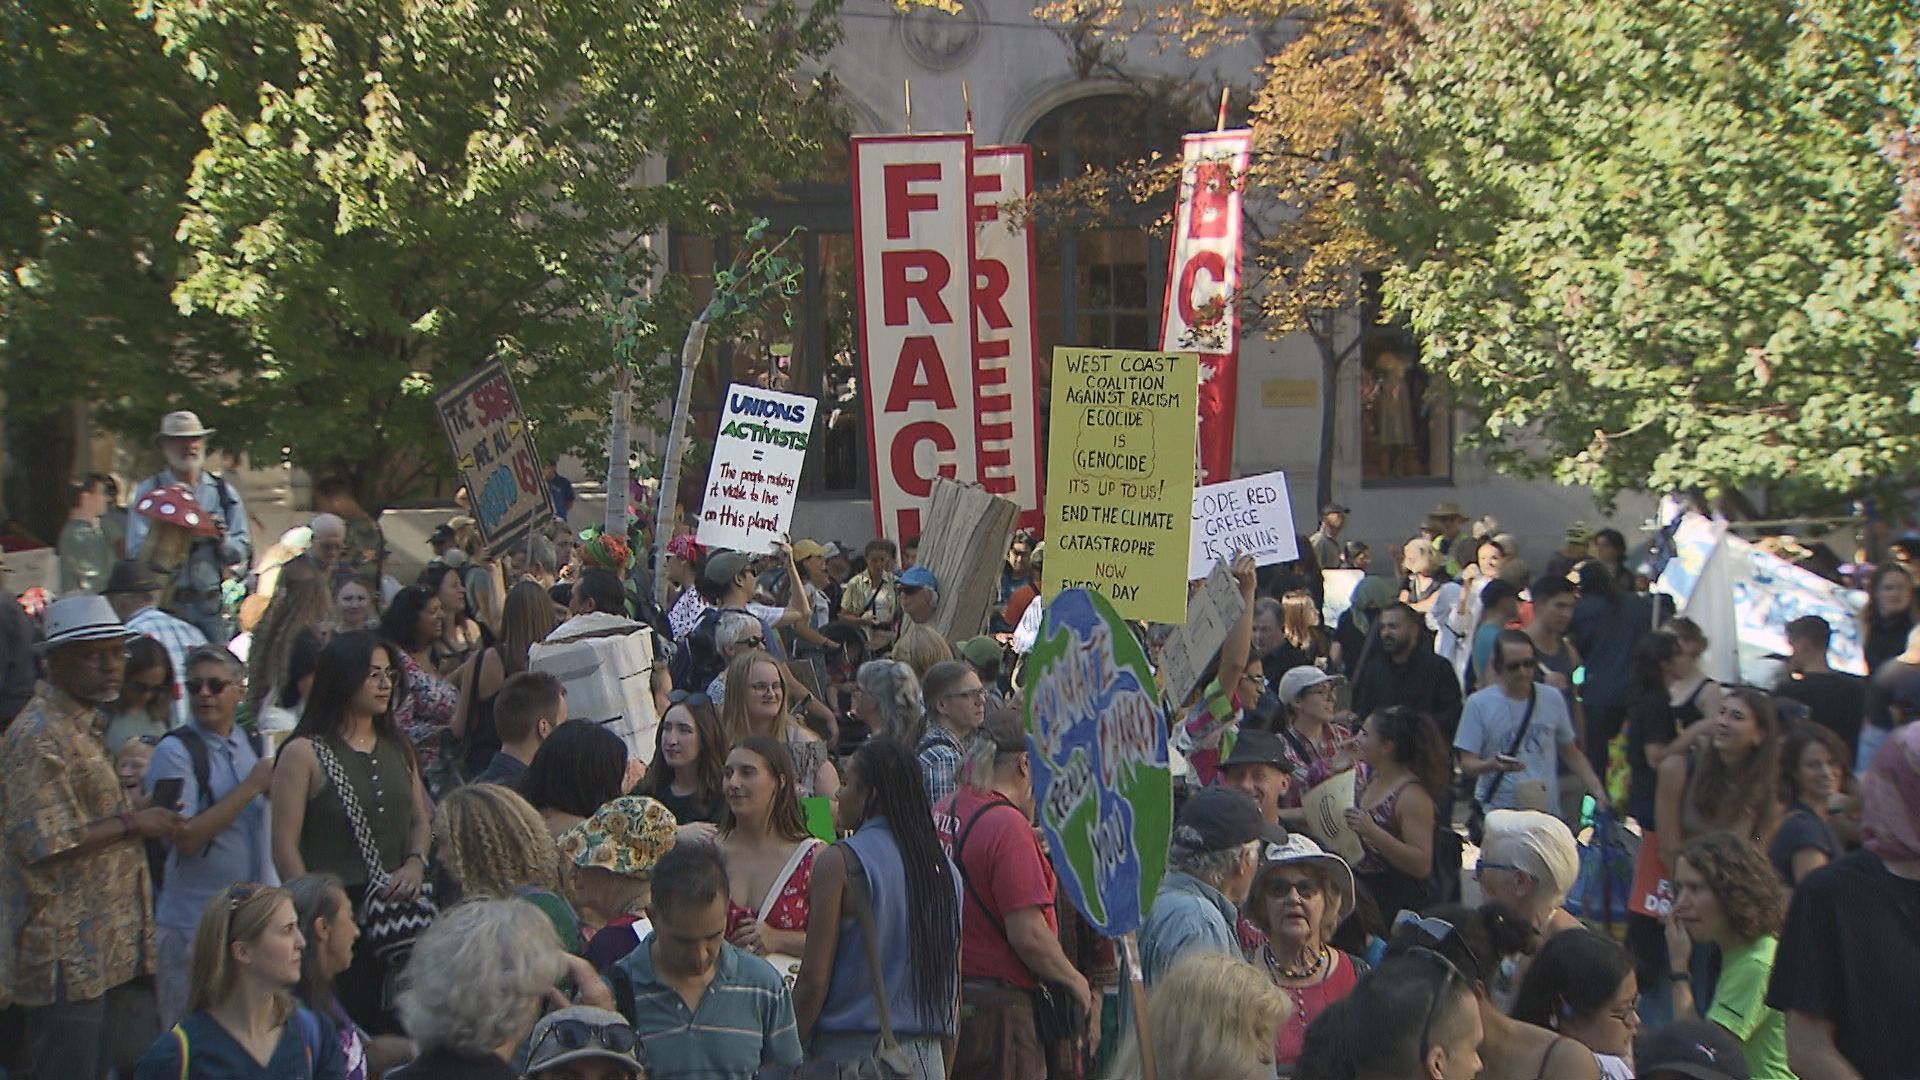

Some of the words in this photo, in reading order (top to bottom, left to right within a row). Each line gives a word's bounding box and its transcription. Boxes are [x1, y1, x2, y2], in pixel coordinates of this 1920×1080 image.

[1178, 163, 1229, 327] BC
[881, 163, 957, 569] FRAC
[1066, 355, 1112, 373] WEST
[1121, 357, 1180, 372] COAST
[1086, 375, 1164, 390] COALITION
[731, 393, 805, 423] UNIONS
[1066, 386, 1125, 404] AGAINST
[1131, 391, 1180, 408] RACISM
[1087, 409, 1143, 426] ECOCIDE
[720, 421, 809, 451] ACTIVISTS
[1113, 433, 1126, 448] IS
[473, 437, 494, 471] ARE
[493, 426, 512, 455] ALL
[512, 448, 538, 495] US
[1077, 450, 1147, 472] GENOCIDE
[720, 462, 737, 479] The
[740, 470, 765, 485] people
[767, 472, 795, 494] making
[1069, 479, 1089, 493] IT'S
[1098, 481, 1115, 496] UP
[1121, 483, 1137, 498] TO
[1140, 480, 1165, 501] US!
[710, 482, 719, 497] it
[750, 484, 759, 501] to
[761, 488, 779, 506] live
[1247, 487, 1277, 505] RED
[705, 510, 717, 522] on
[719, 504, 745, 528] this
[746, 511, 779, 536] planet
[1061, 505, 1088, 522] END
[1092, 507, 1118, 524] THE
[1121, 509, 1174, 530] CLIMATE
[1205, 509, 1260, 536] GREECE
[1060, 535, 1156, 556] CATASTROPHE
[1202, 540, 1222, 560] IS
[1224, 528, 1279, 557] SINKING
[1095, 562, 1127, 578] NOW
[1112, 583, 1140, 601] DAY
